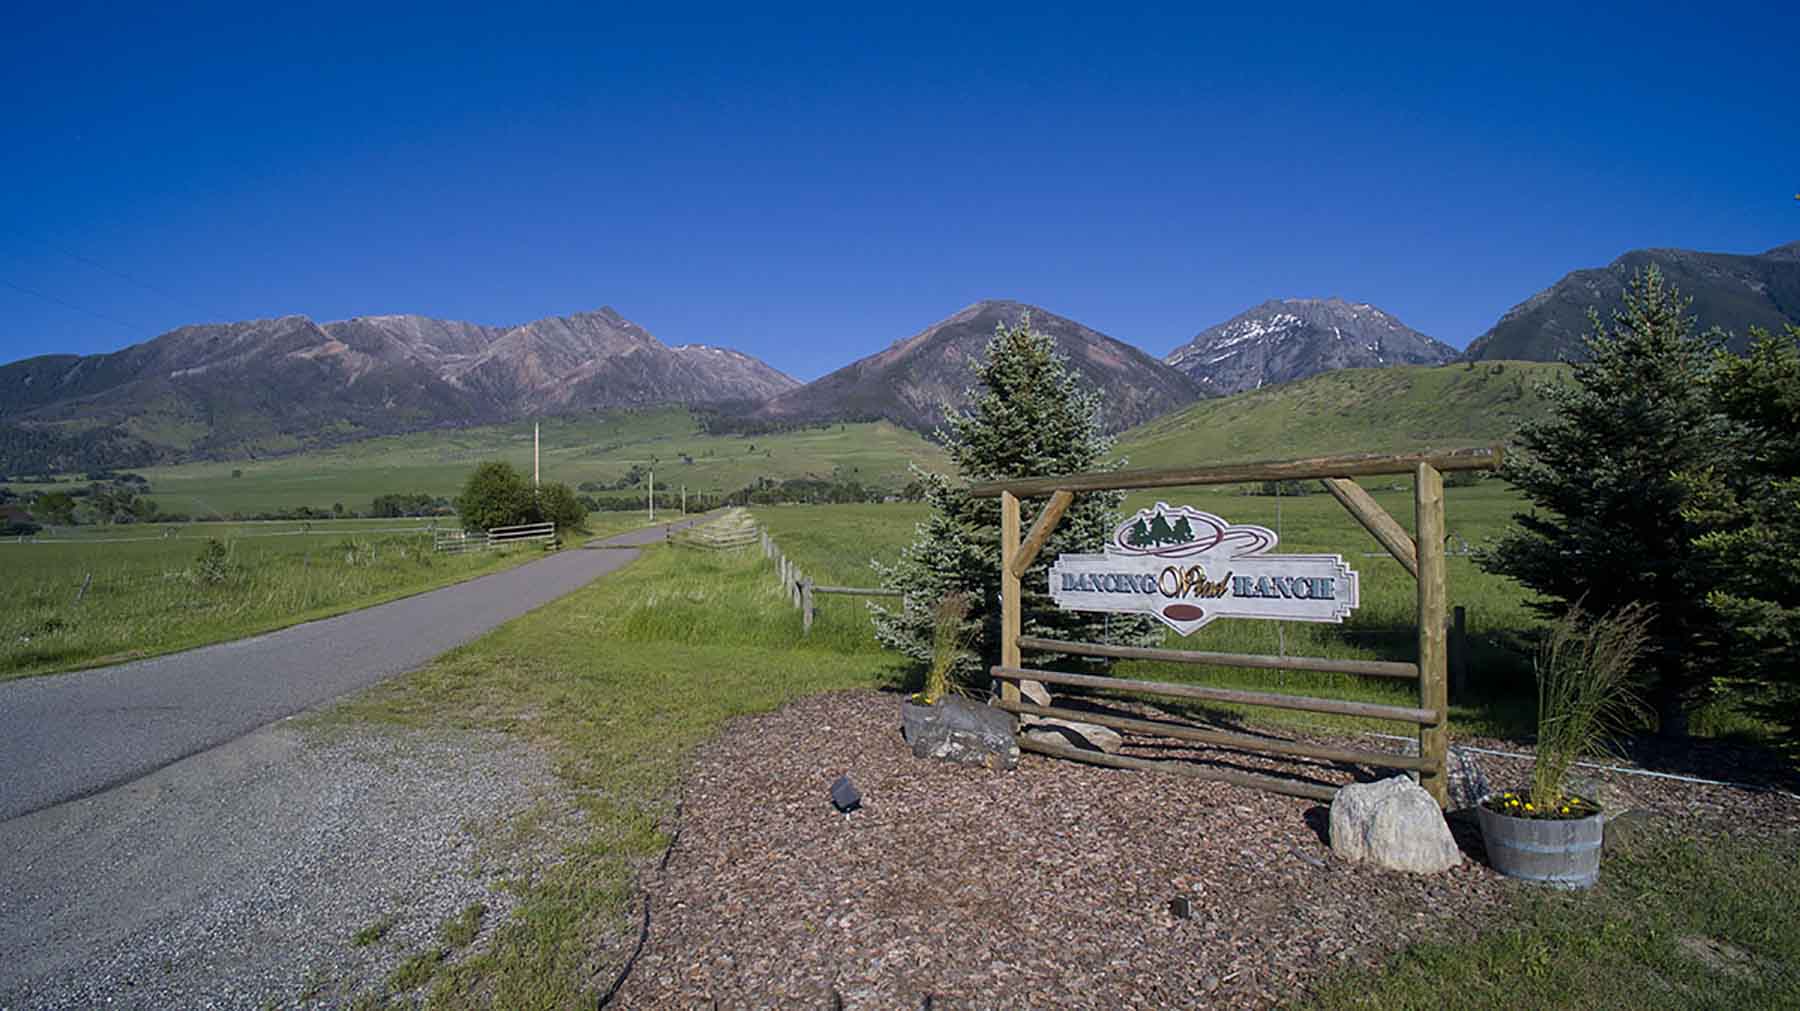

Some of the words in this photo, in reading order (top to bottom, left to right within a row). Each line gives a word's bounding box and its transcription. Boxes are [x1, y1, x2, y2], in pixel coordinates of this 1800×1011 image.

[1062, 573, 1157, 594] DANCING
[1158, 565, 1233, 599] Wind
[1232, 576, 1335, 600] RANCH
